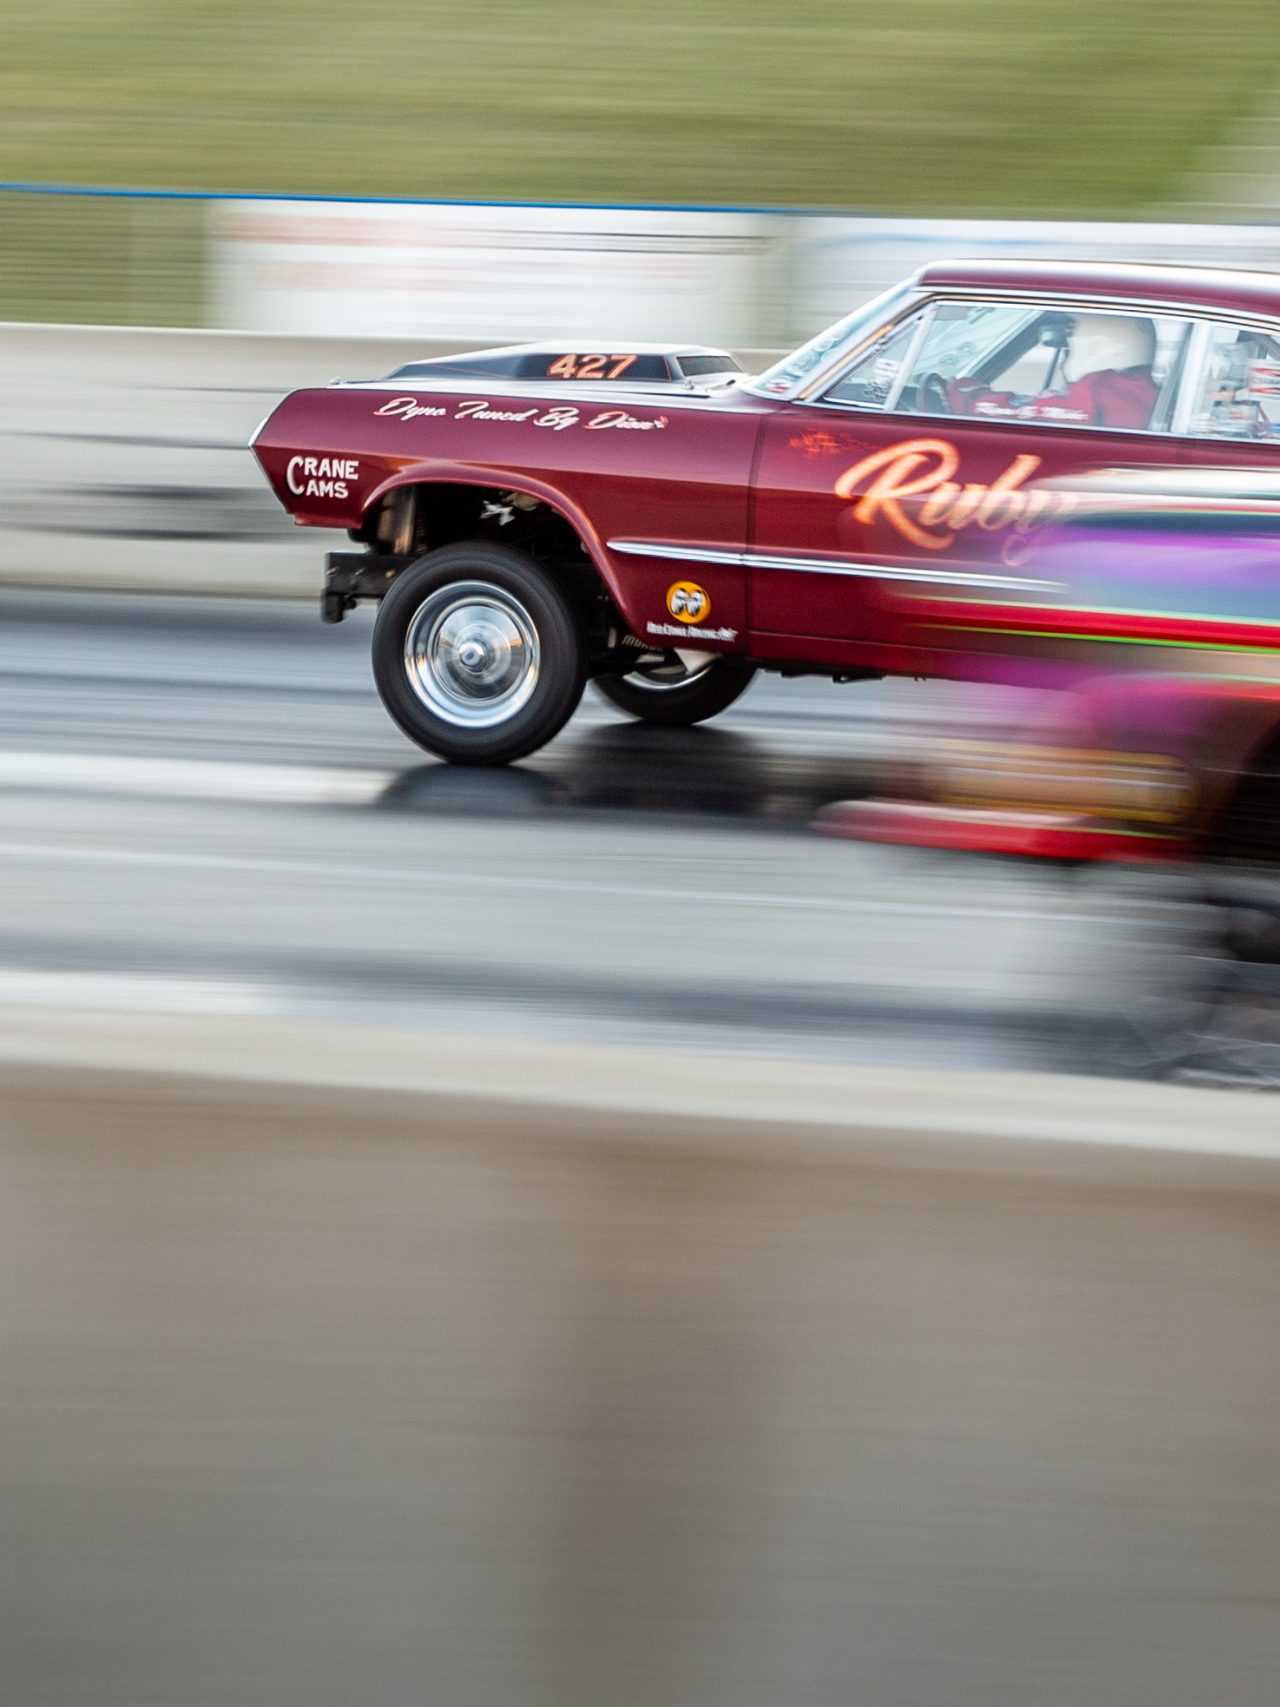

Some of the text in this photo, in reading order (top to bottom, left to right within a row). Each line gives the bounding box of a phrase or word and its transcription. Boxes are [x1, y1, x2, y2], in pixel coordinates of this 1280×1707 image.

[547, 353, 638, 379] 427
[373, 397, 447, 421] Dyno
[454, 400, 538, 422] Tuned
[533, 406, 580, 431] By
[287, 455, 359, 495] CRANE
[834, 437, 1079, 567] Ruby
